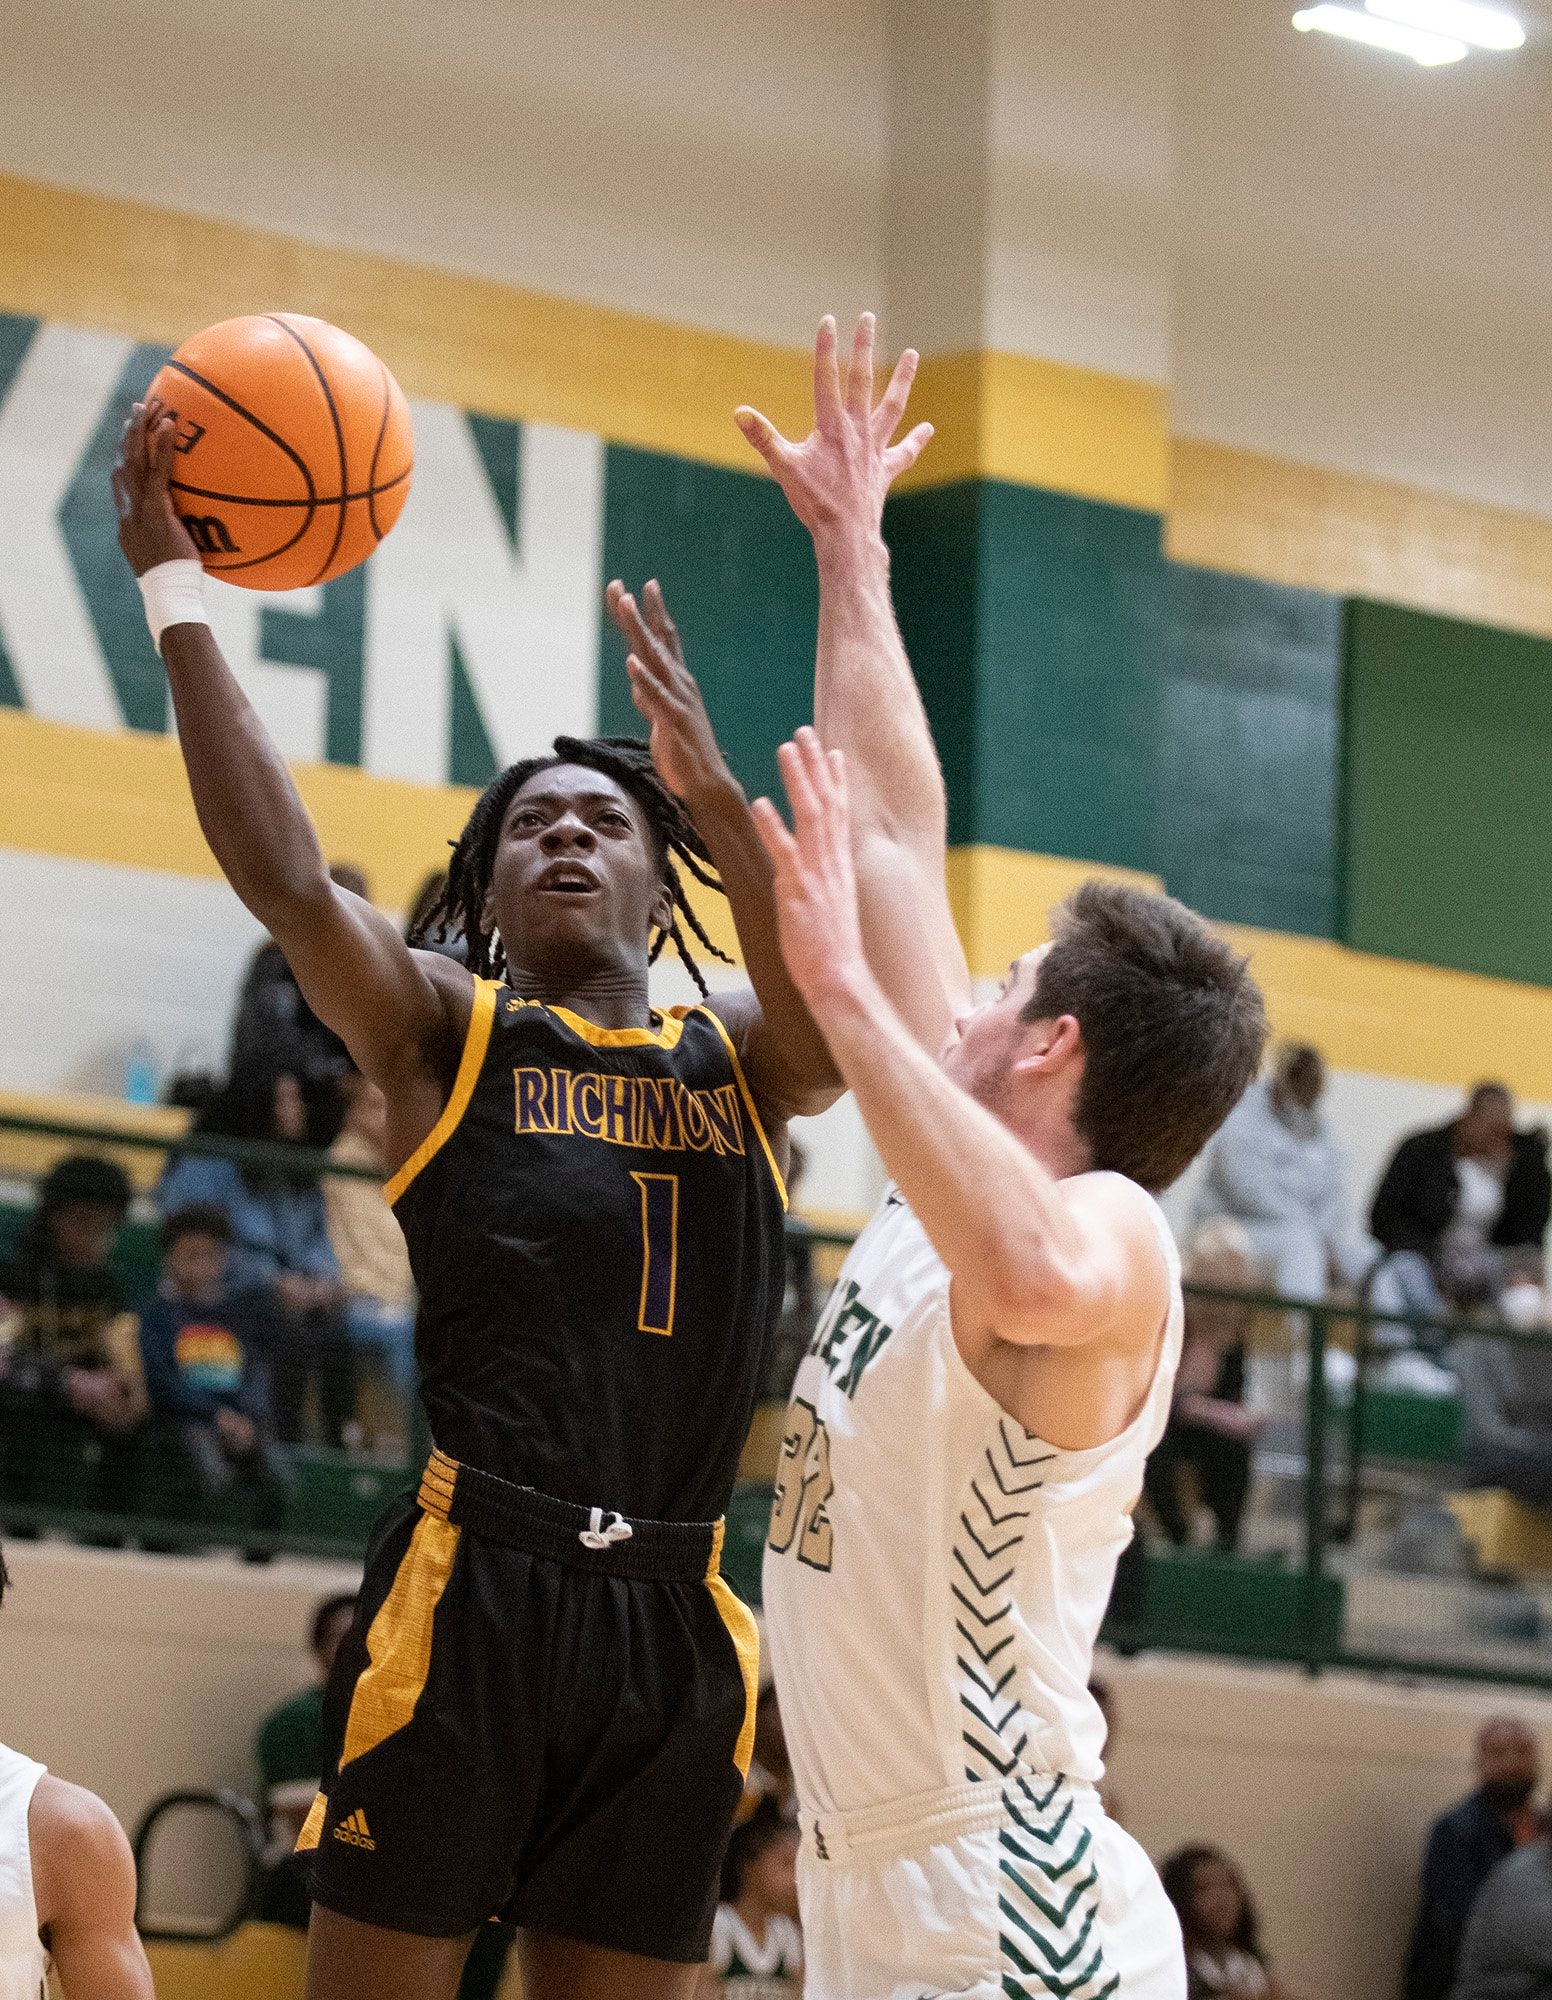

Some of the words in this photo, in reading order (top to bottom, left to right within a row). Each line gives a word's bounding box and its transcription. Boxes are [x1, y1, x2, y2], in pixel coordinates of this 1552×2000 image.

[512, 1066, 746, 1156] RICHMON
[629, 1170, 679, 1337] 1
[333, 1827, 376, 1851] adidas
